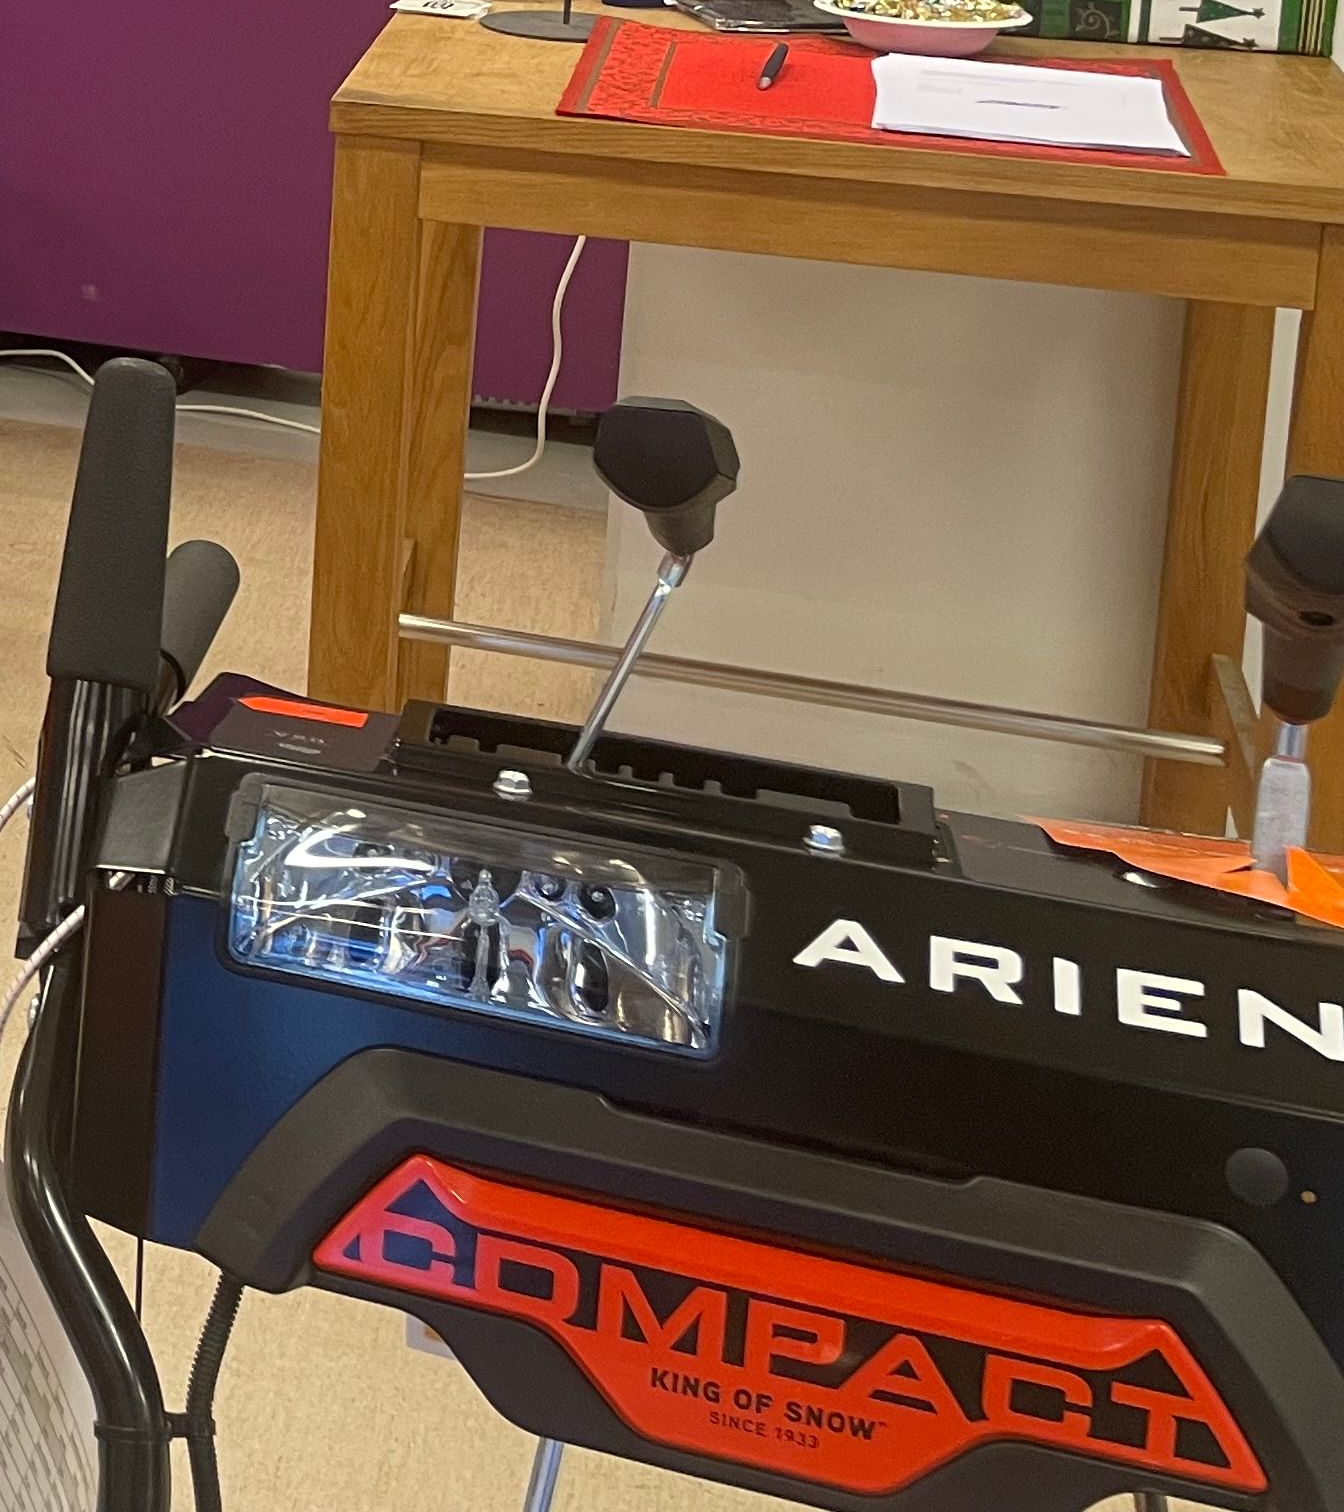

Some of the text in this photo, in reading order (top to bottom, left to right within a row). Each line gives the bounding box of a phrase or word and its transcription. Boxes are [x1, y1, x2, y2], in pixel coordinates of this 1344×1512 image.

[359, 1210, 1212, 1466] COMPACT
[650, 1367, 877, 1441] KING OF SNOW
[710, 1411, 820, 1450] SINCE 1933
